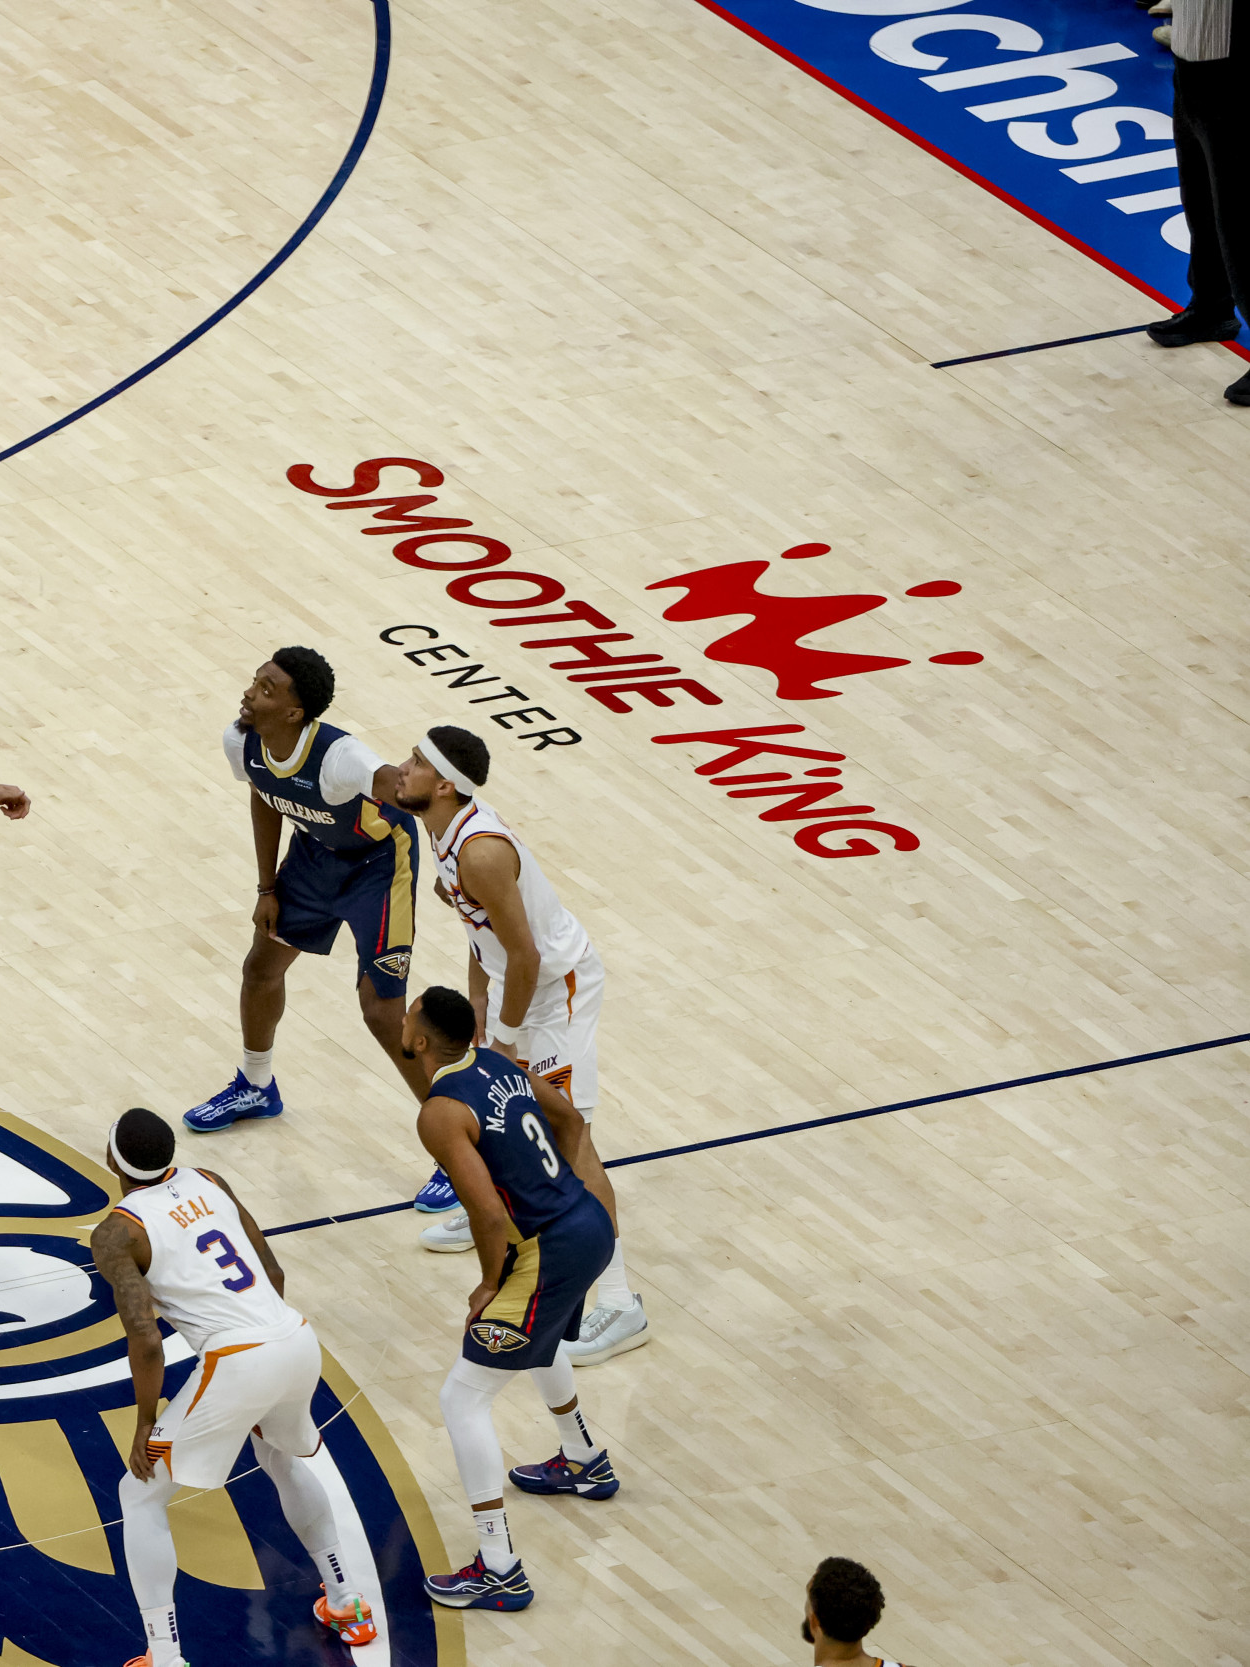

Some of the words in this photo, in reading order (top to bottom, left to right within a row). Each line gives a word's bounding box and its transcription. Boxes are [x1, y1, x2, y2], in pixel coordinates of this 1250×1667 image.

[285, 456, 723, 713] SMOOTHIE
[379, 624, 583, 751] CENTER
[272, 795, 336, 825] ORLEANS
[531, 1054, 558, 1075] ENIX
[521, 1112, 559, 1179] 3
[168, 1195, 215, 1229] BEAL
[196, 1229, 256, 1293] 3
